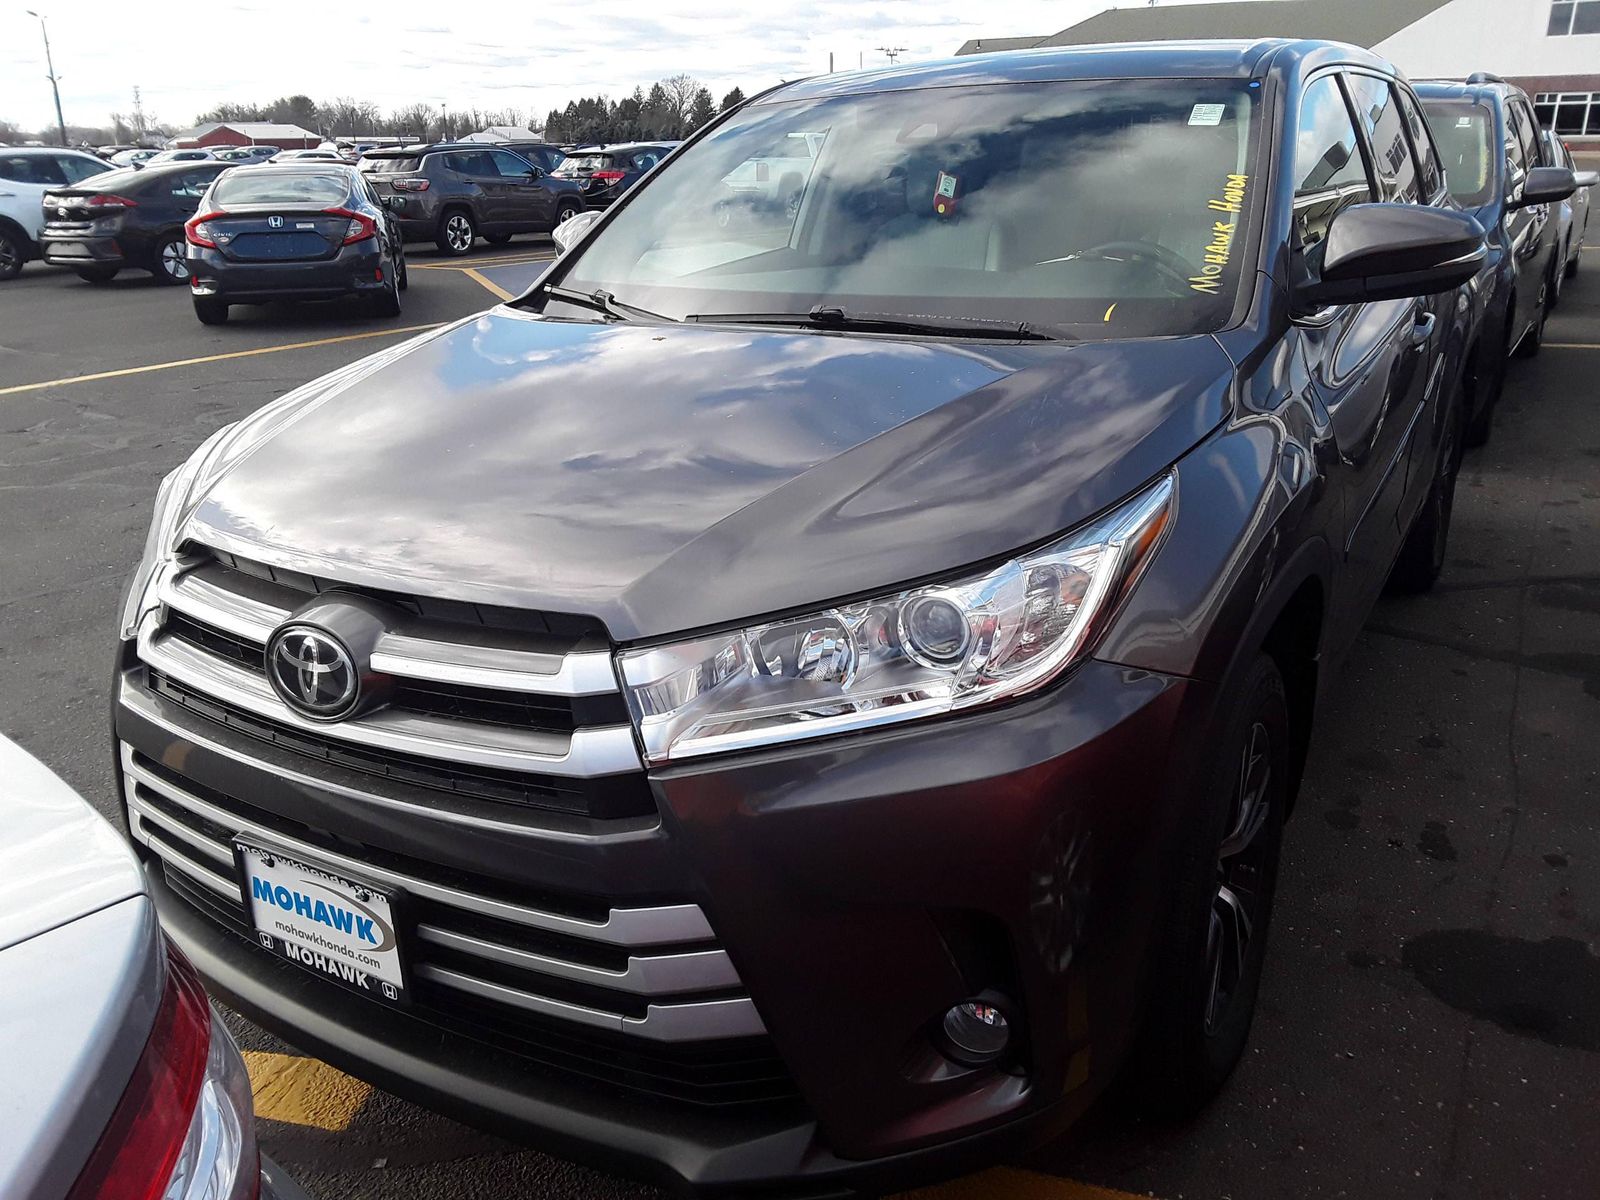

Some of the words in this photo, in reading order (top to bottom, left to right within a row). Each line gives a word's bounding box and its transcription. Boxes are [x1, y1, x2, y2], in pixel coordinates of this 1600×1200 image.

[252, 876, 377, 945] MOHAWK
[275, 920, 381, 969] mohawkhonda.com
[284, 941, 370, 990] MOHAWK
